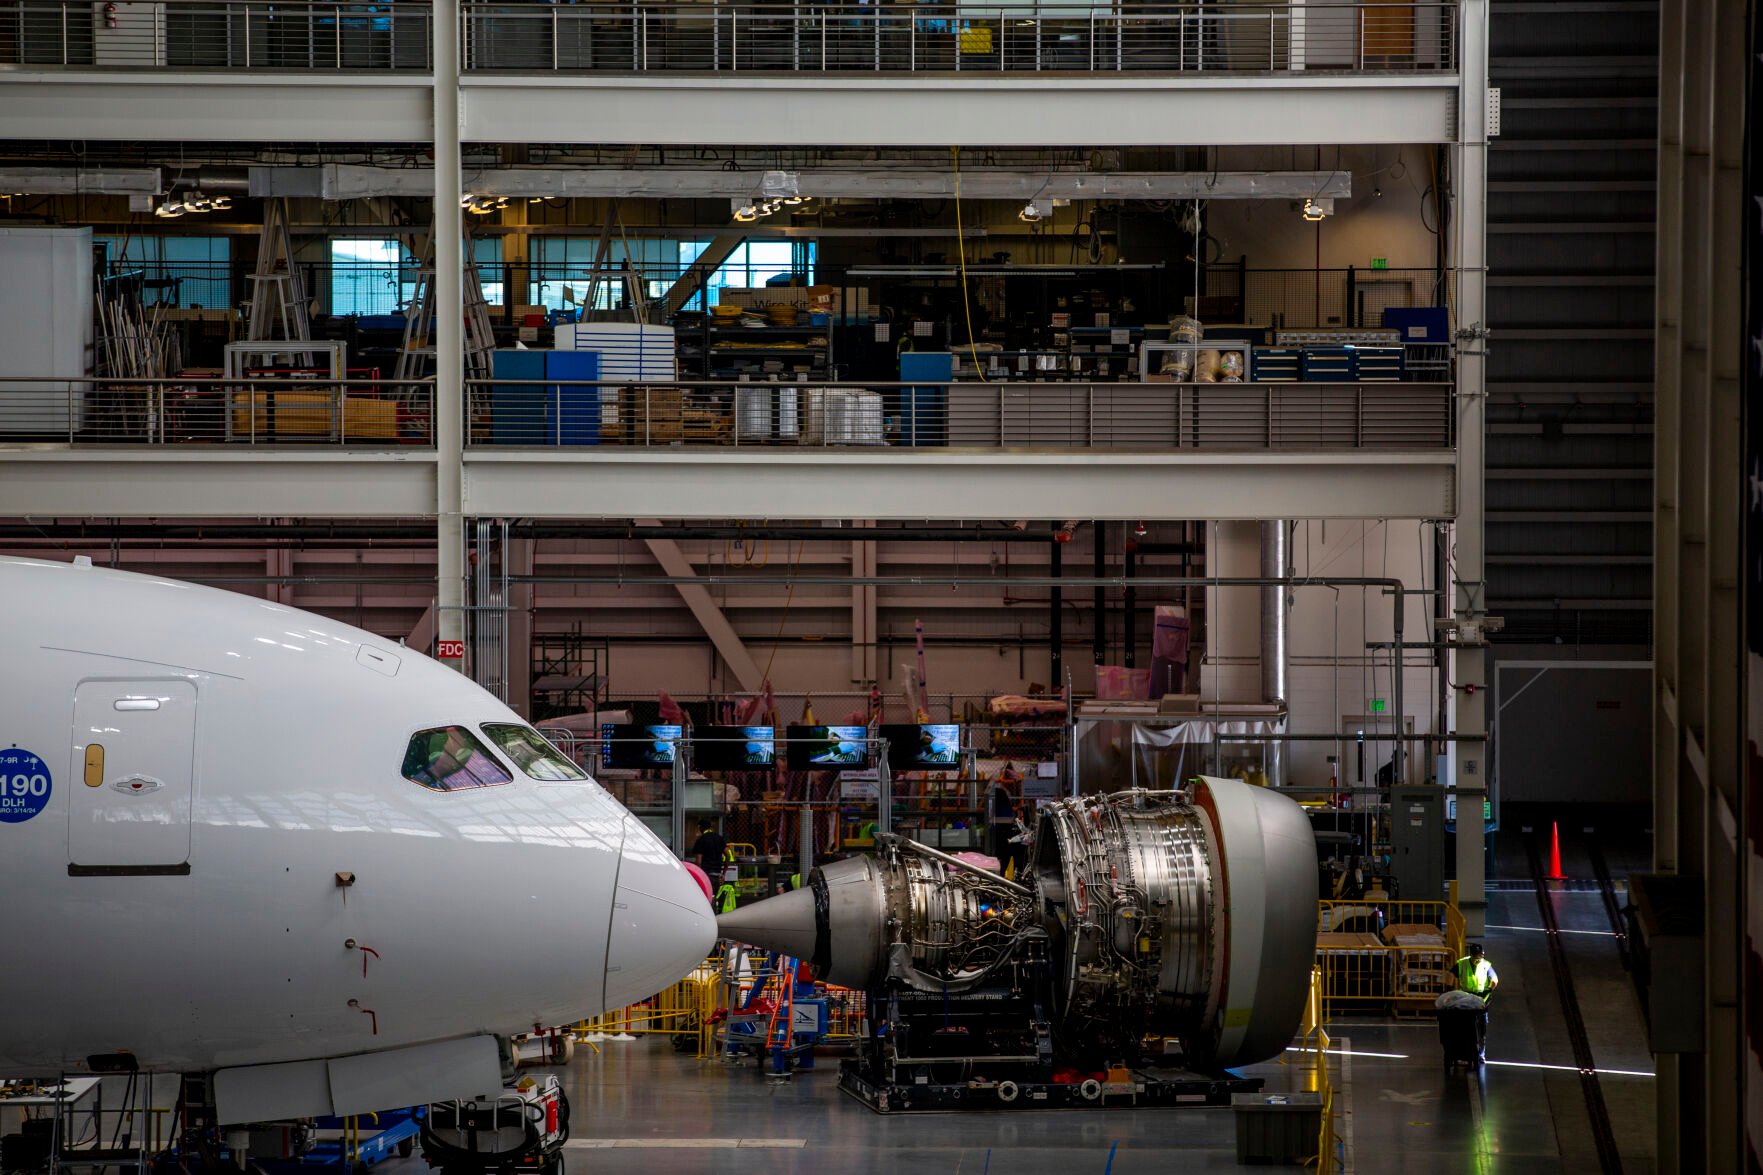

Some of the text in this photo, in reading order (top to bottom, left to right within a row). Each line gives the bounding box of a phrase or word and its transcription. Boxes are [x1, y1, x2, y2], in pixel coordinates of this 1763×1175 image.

[438, 643, 463, 656] FDC
[0, 774, 48, 797] 190
[2, 798, 25, 807] DLH
